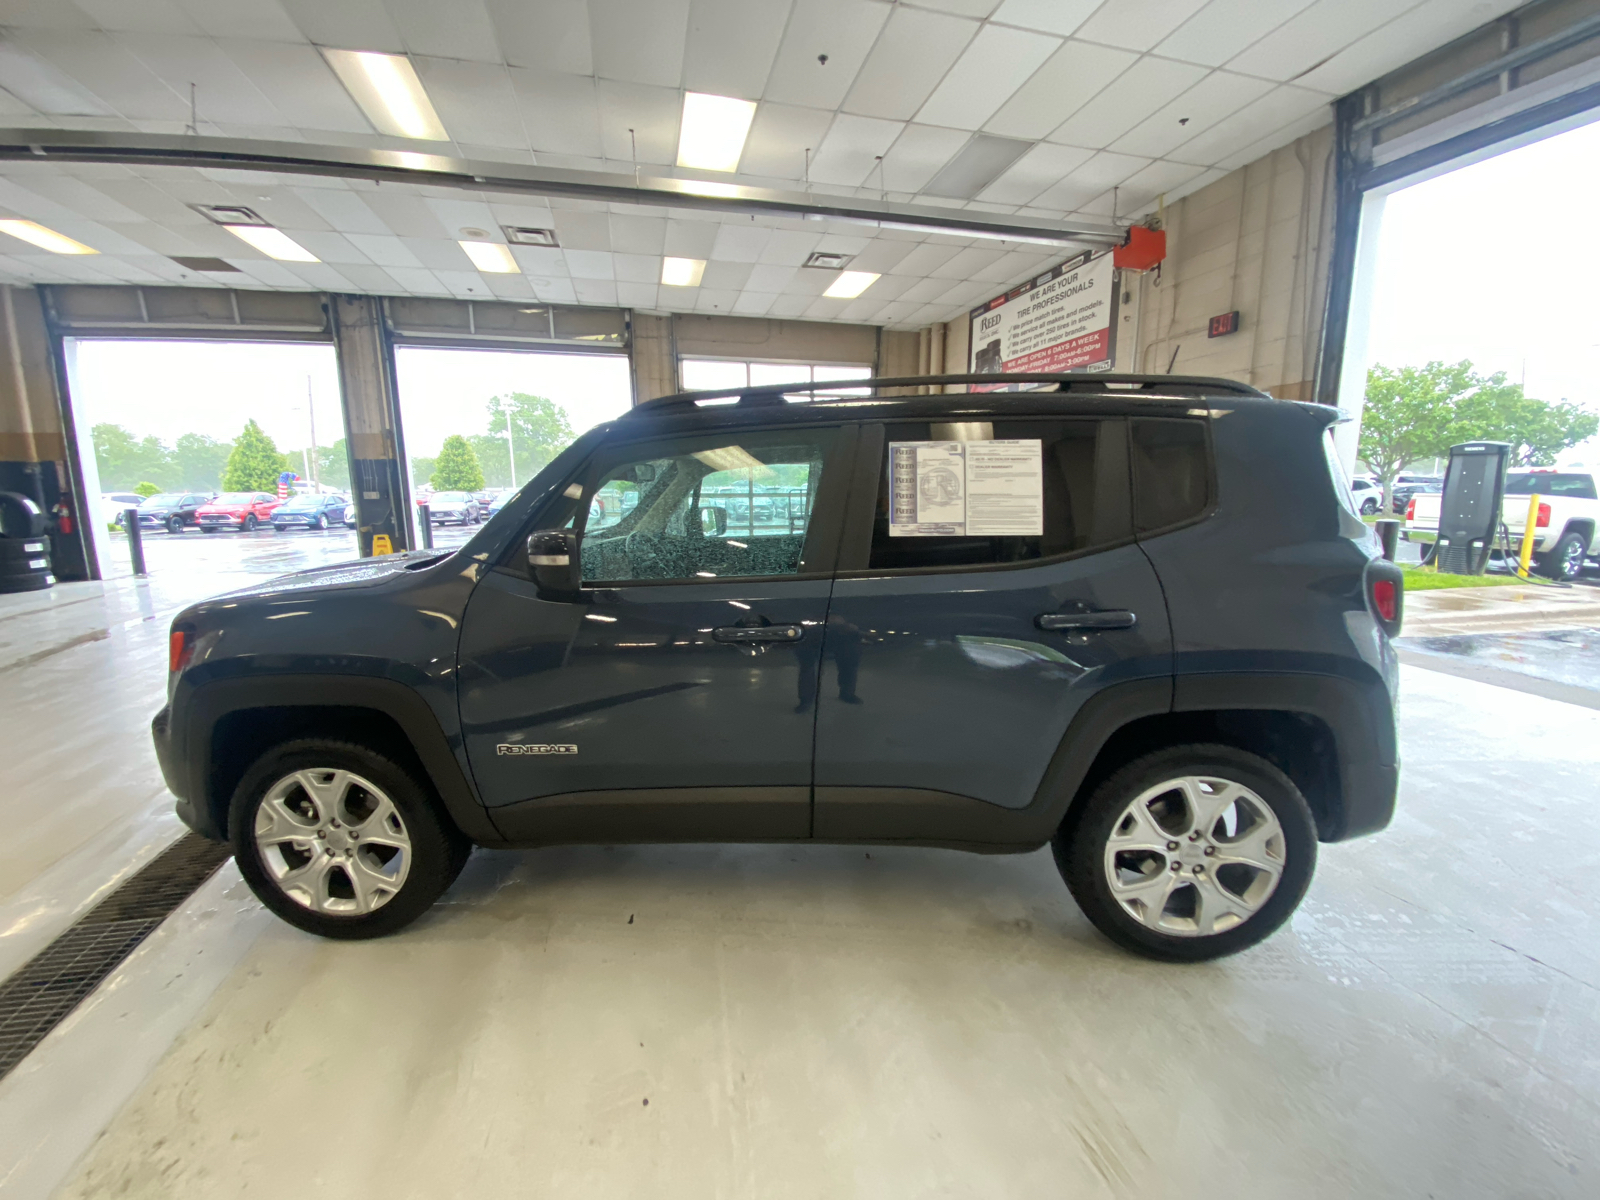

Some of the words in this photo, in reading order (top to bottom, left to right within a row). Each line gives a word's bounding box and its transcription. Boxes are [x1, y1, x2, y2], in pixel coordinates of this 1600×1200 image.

[1017, 306, 1031, 319] TIRE
[1032, 278, 1094, 312] PROFESSIONALS
[1030, 291, 1040, 302] WE
[1042, 283, 1056, 296] ARE
[1057, 272, 1078, 288] YOUR
[1020, 319, 1033, 329] price
[1034, 311, 1050, 322] match
[1051, 306, 1066, 318] tires.
[1020, 326, 1038, 336] service
[1046, 315, 1064, 326] makes
[1066, 309, 1078, 318] and
[1078, 300, 1104, 314] models.
[1020, 336, 1032, 345] carry
[1057, 322, 1070, 332] tires
[1078, 312, 1098, 323] stock.
[1213, 313, 1232, 334] EXIT
[1018, 356, 1028, 364] ARE
[1030, 351, 1046, 360] OPEN
[1052, 342, 1069, 354] DAYS
[1078, 334, 1100, 345] WEEK
[1020, 344, 1032, 353] carry
[1048, 333, 1063, 344] major
[1064, 326, 1088, 338] brands.
[497, 744, 578, 756] RENEGADE
